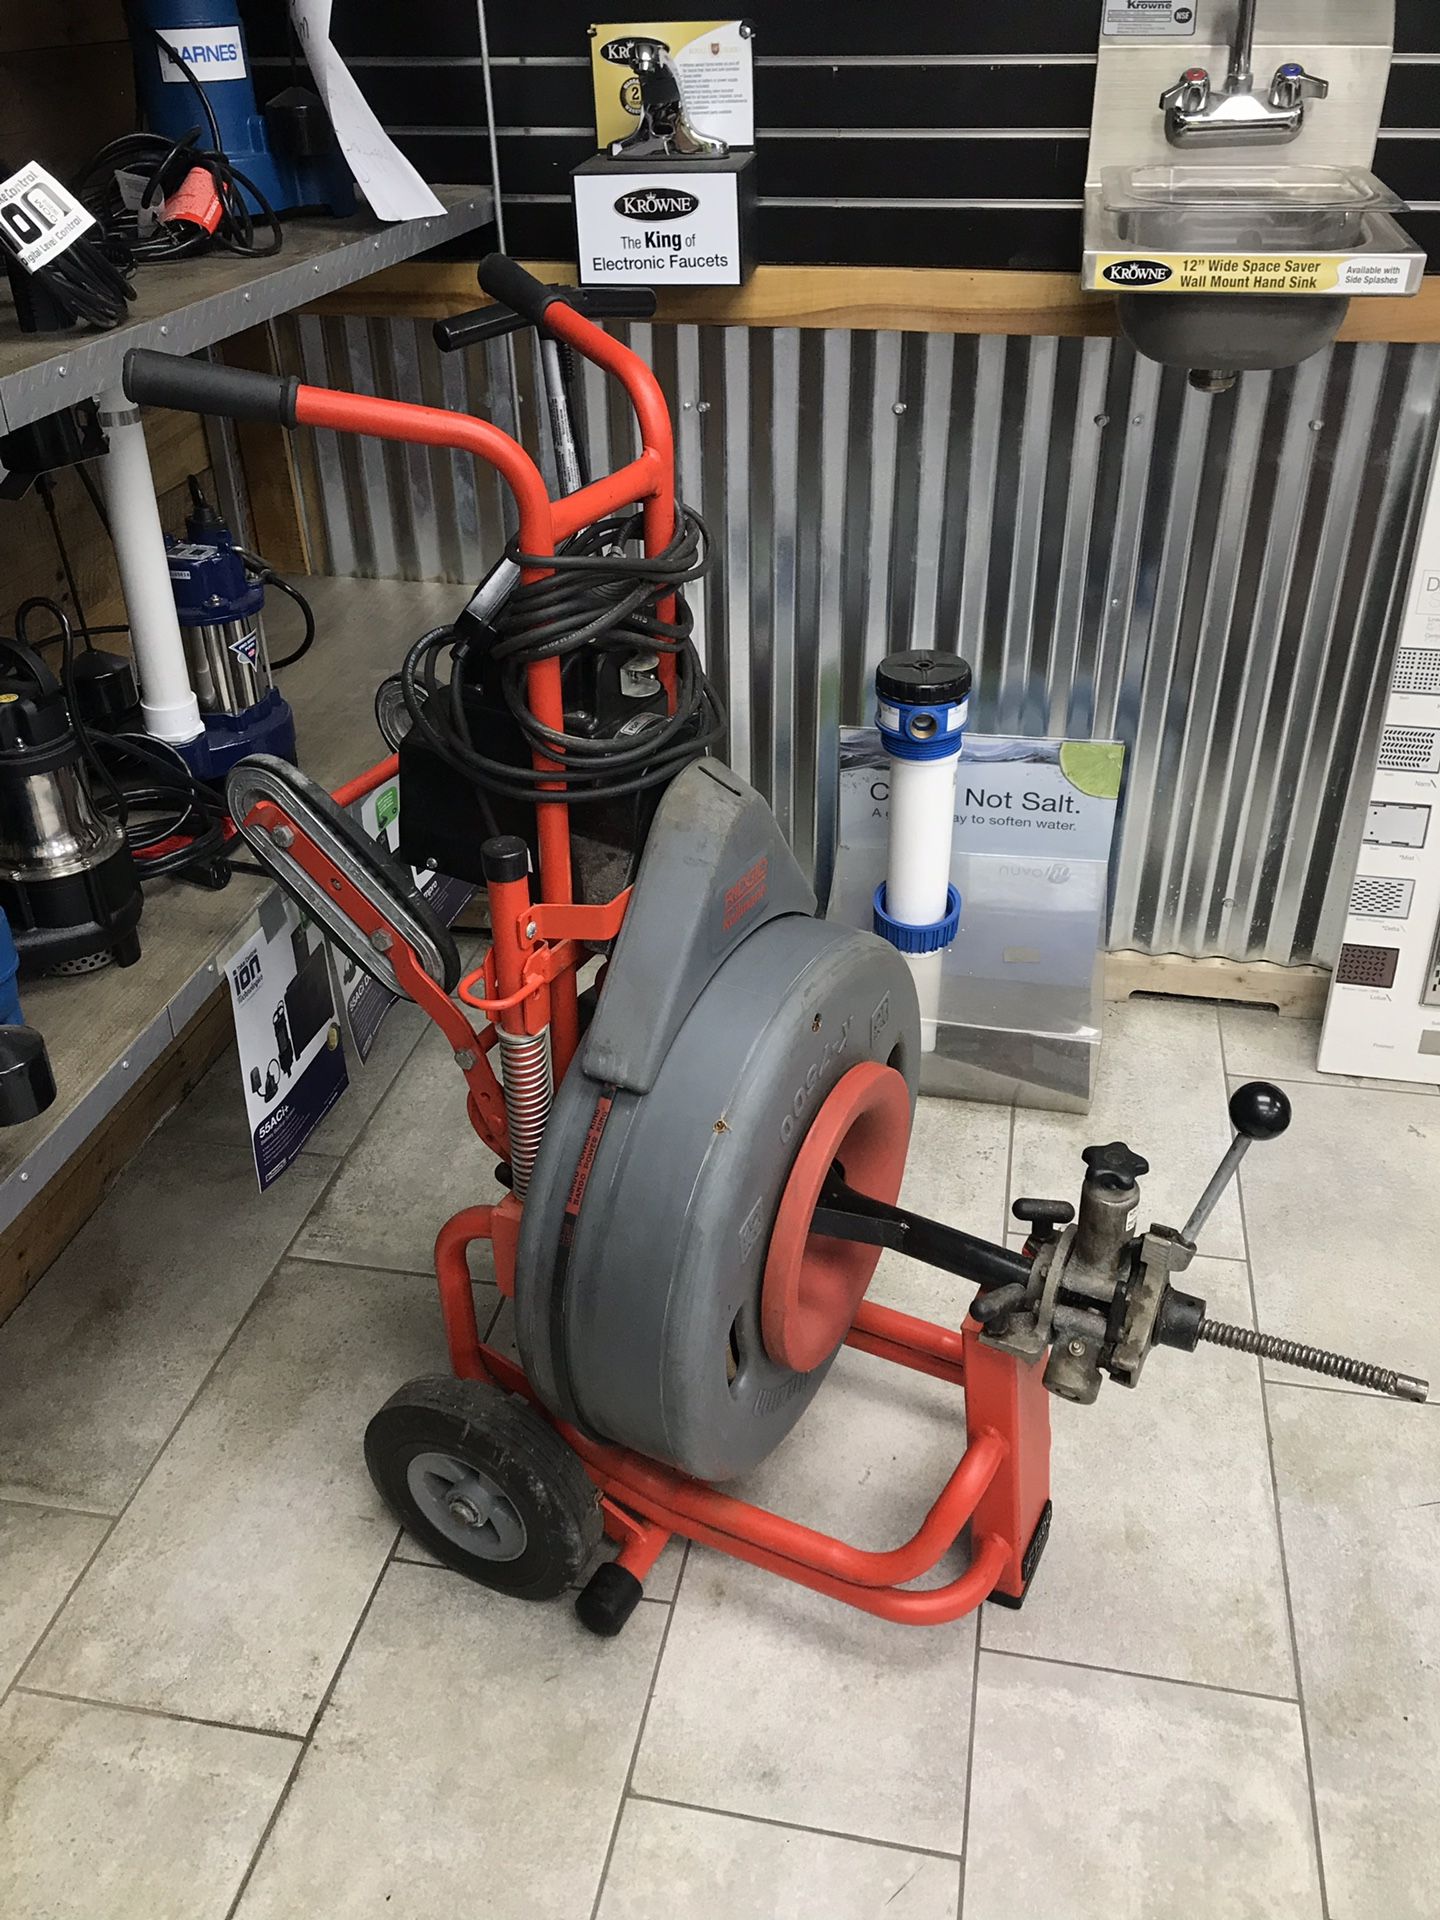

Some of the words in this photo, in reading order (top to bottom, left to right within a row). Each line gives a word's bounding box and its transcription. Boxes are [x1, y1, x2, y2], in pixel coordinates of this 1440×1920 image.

[631, 86, 640, 101] 2
[622, 196, 692, 214] KROWNE
[55, 215, 83, 241] Control
[620, 236, 642, 250] The
[645, 231, 682, 252] King
[684, 233, 697, 248] of
[592, 256, 665, 271] Electronic
[669, 253, 729, 269] Faucets
[1208, 260, 1239, 272] Wide
[1242, 260, 1281, 274] Space
[1284, 260, 1321, 272] Saver
[1346, 266, 1382, 274] Available
[1383, 266, 1401, 274] with
[1109, 265, 1167, 280] KROWNE
[1345, 275, 1362, 284] Side
[1363, 275, 1399, 285] Splashes
[1180, 275, 1207, 288] Wall
[1209, 276, 1250, 288] Mount
[1253, 276, 1286, 288] Hand
[1289, 276, 1317, 289] Sink
[965, 788, 1013, 809] Not
[1021, 791, 1081, 814] Salt.
[872, 807, 882, 818] A
[953, 814, 968, 826] ay
[971, 814, 985, 825] to
[988, 816, 1032, 828] soften
[1035, 820, 1077, 832] water.
[232, 953, 262, 997] ion
